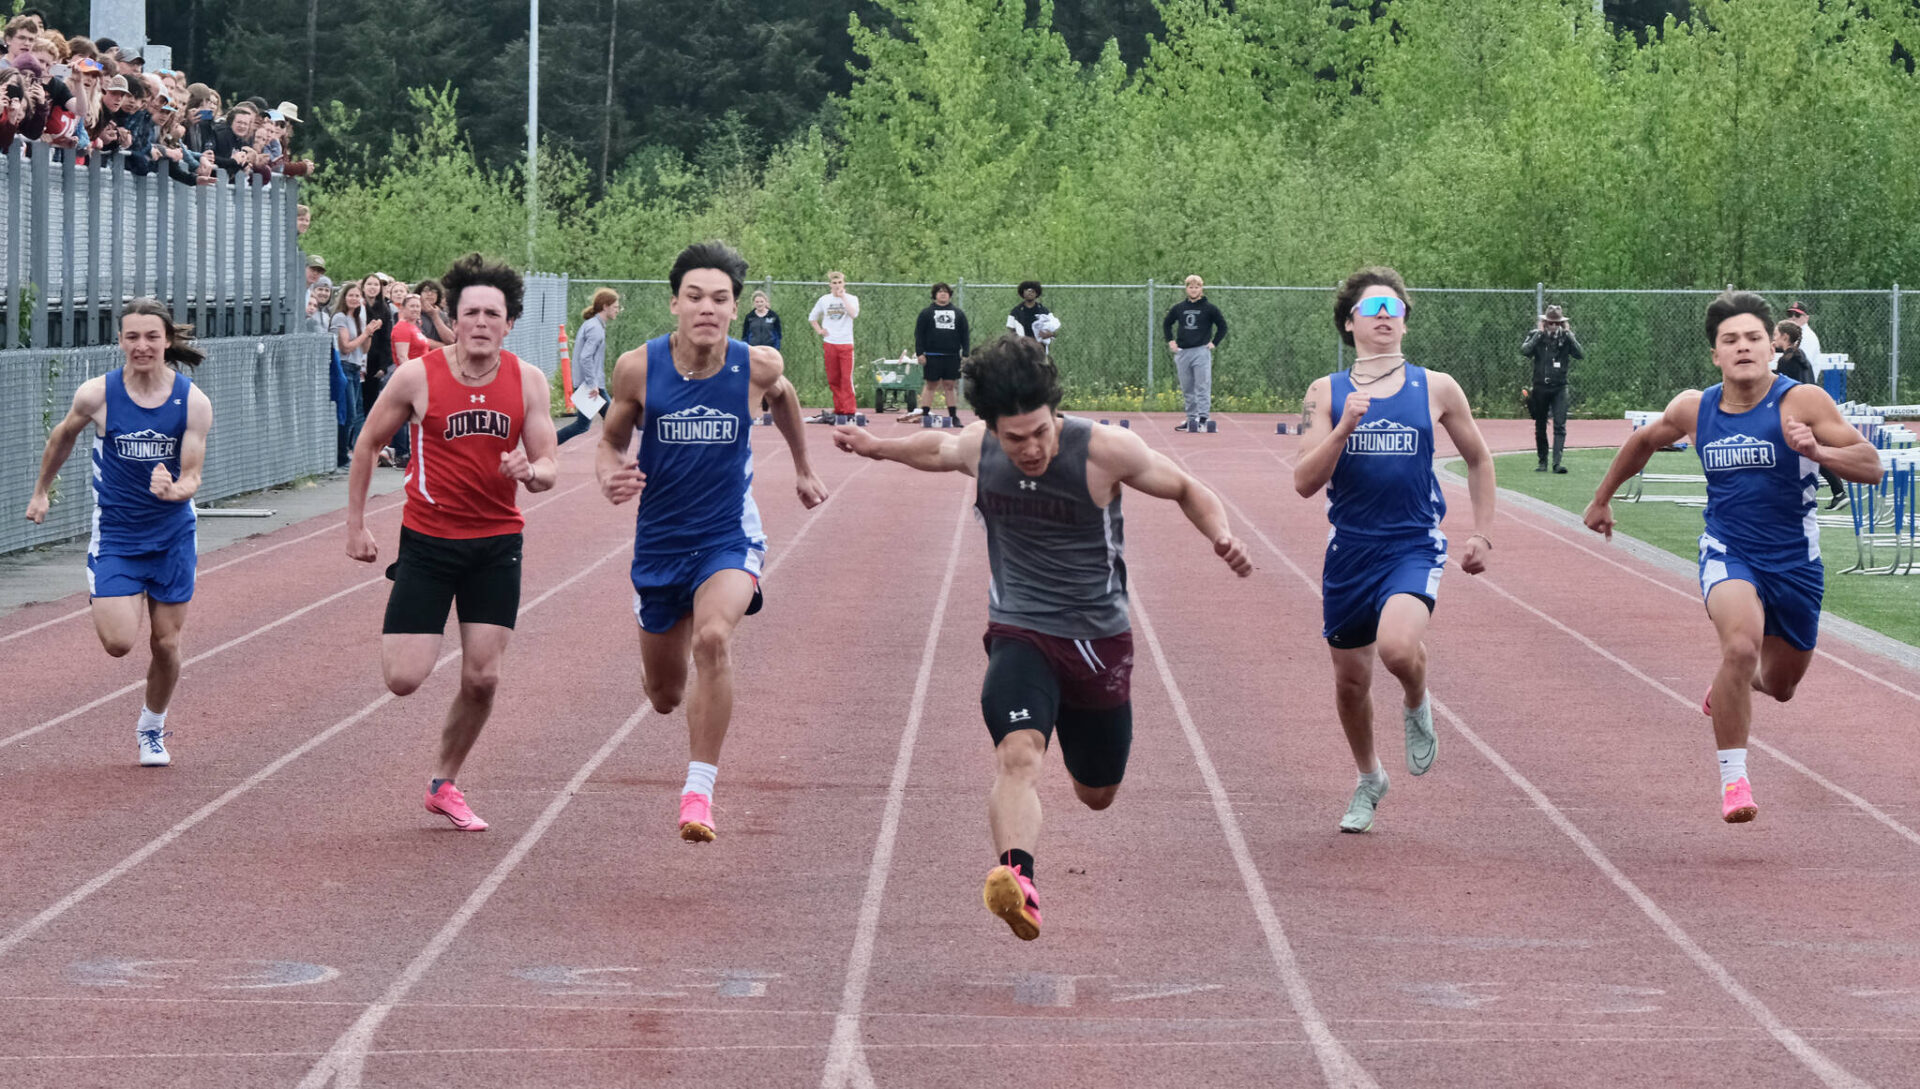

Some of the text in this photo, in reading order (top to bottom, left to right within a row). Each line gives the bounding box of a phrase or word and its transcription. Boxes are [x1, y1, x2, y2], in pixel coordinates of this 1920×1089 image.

[444, 409, 510, 440] JUNEAU
[662, 421, 733, 440] THUNDER
[119, 440, 174, 458] THUNDER
[1350, 433, 1413, 451] THUNDER
[1707, 447, 1771, 468] THUNDER
